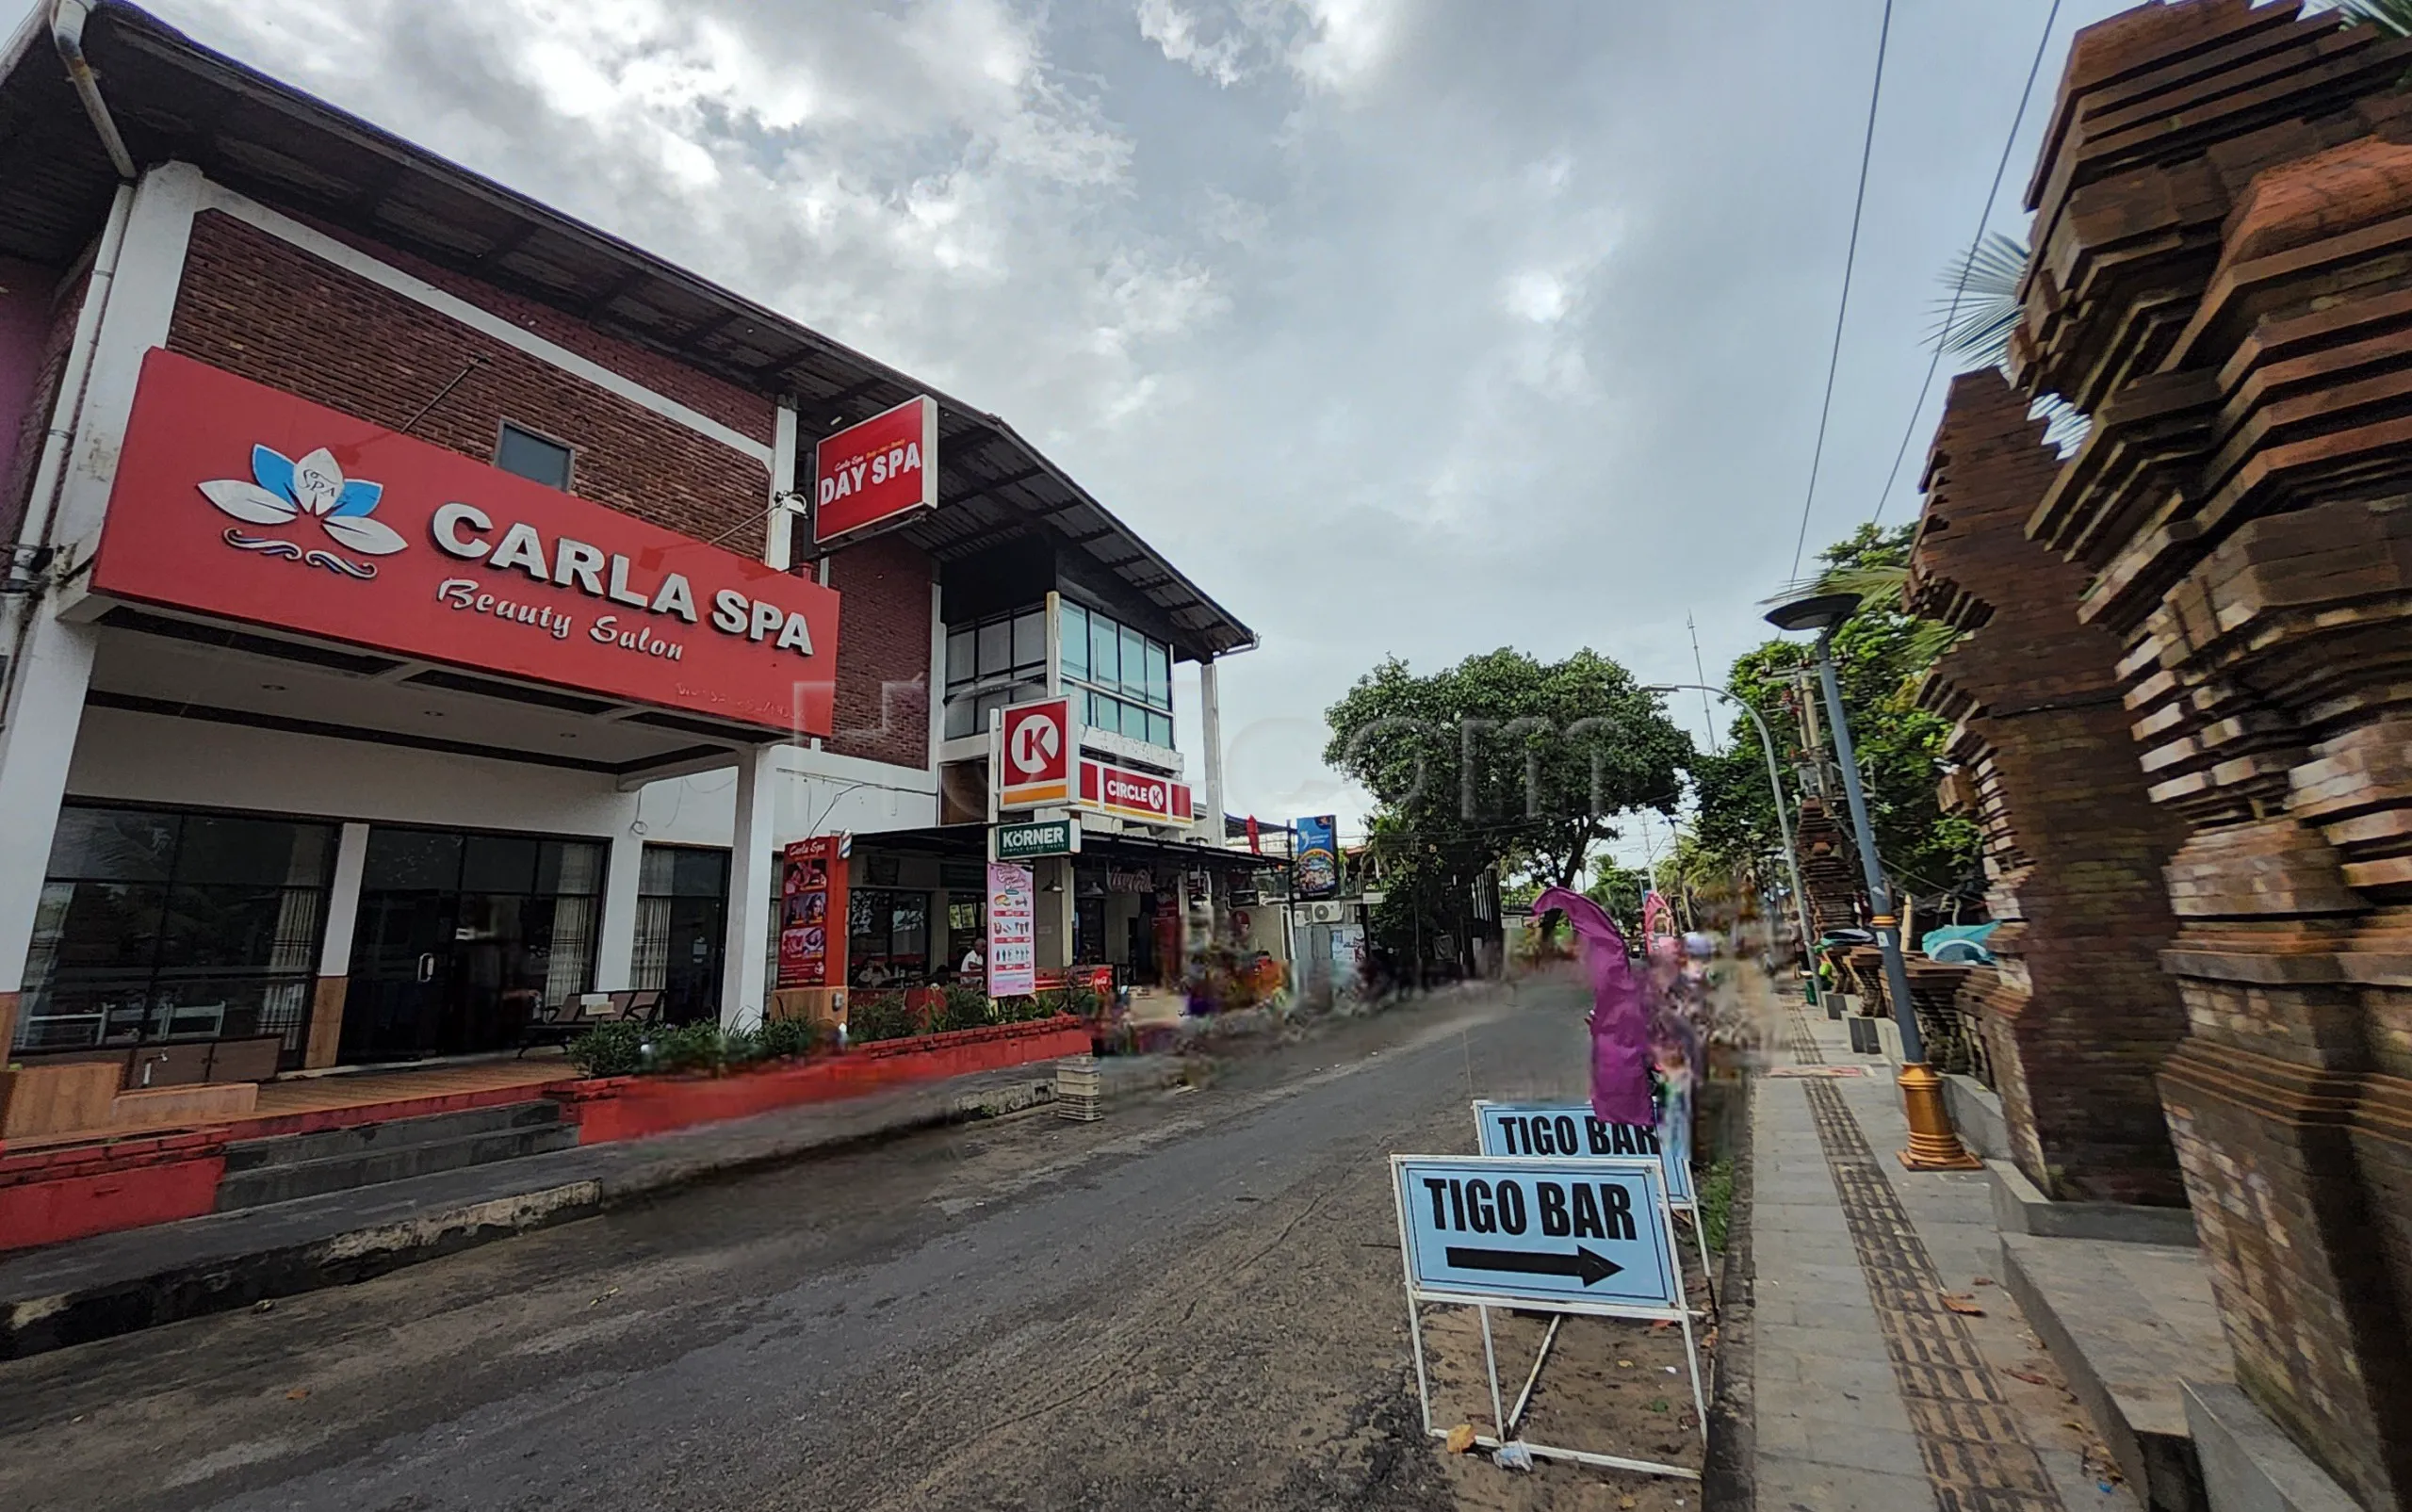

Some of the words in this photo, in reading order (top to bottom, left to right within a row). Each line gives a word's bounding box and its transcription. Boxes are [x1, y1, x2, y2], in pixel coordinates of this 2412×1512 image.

[820, 462, 867, 506] DAY
[872, 442, 921, 485] SPA
[432, 502, 699, 624] CARLA
[712, 588, 815, 657] SPA
[436, 577, 573, 640] Beauty
[589, 615, 685, 661] Salon
[1106, 780, 1148, 804] CIRCLE
[1002, 826, 1065, 849] KÖRNER
[1497, 1114, 1579, 1156] TIGO
[1584, 1115, 1660, 1156] BAR
[1423, 1177, 1527, 1236] TIGO
[1535, 1180, 1638, 1241] BAR
